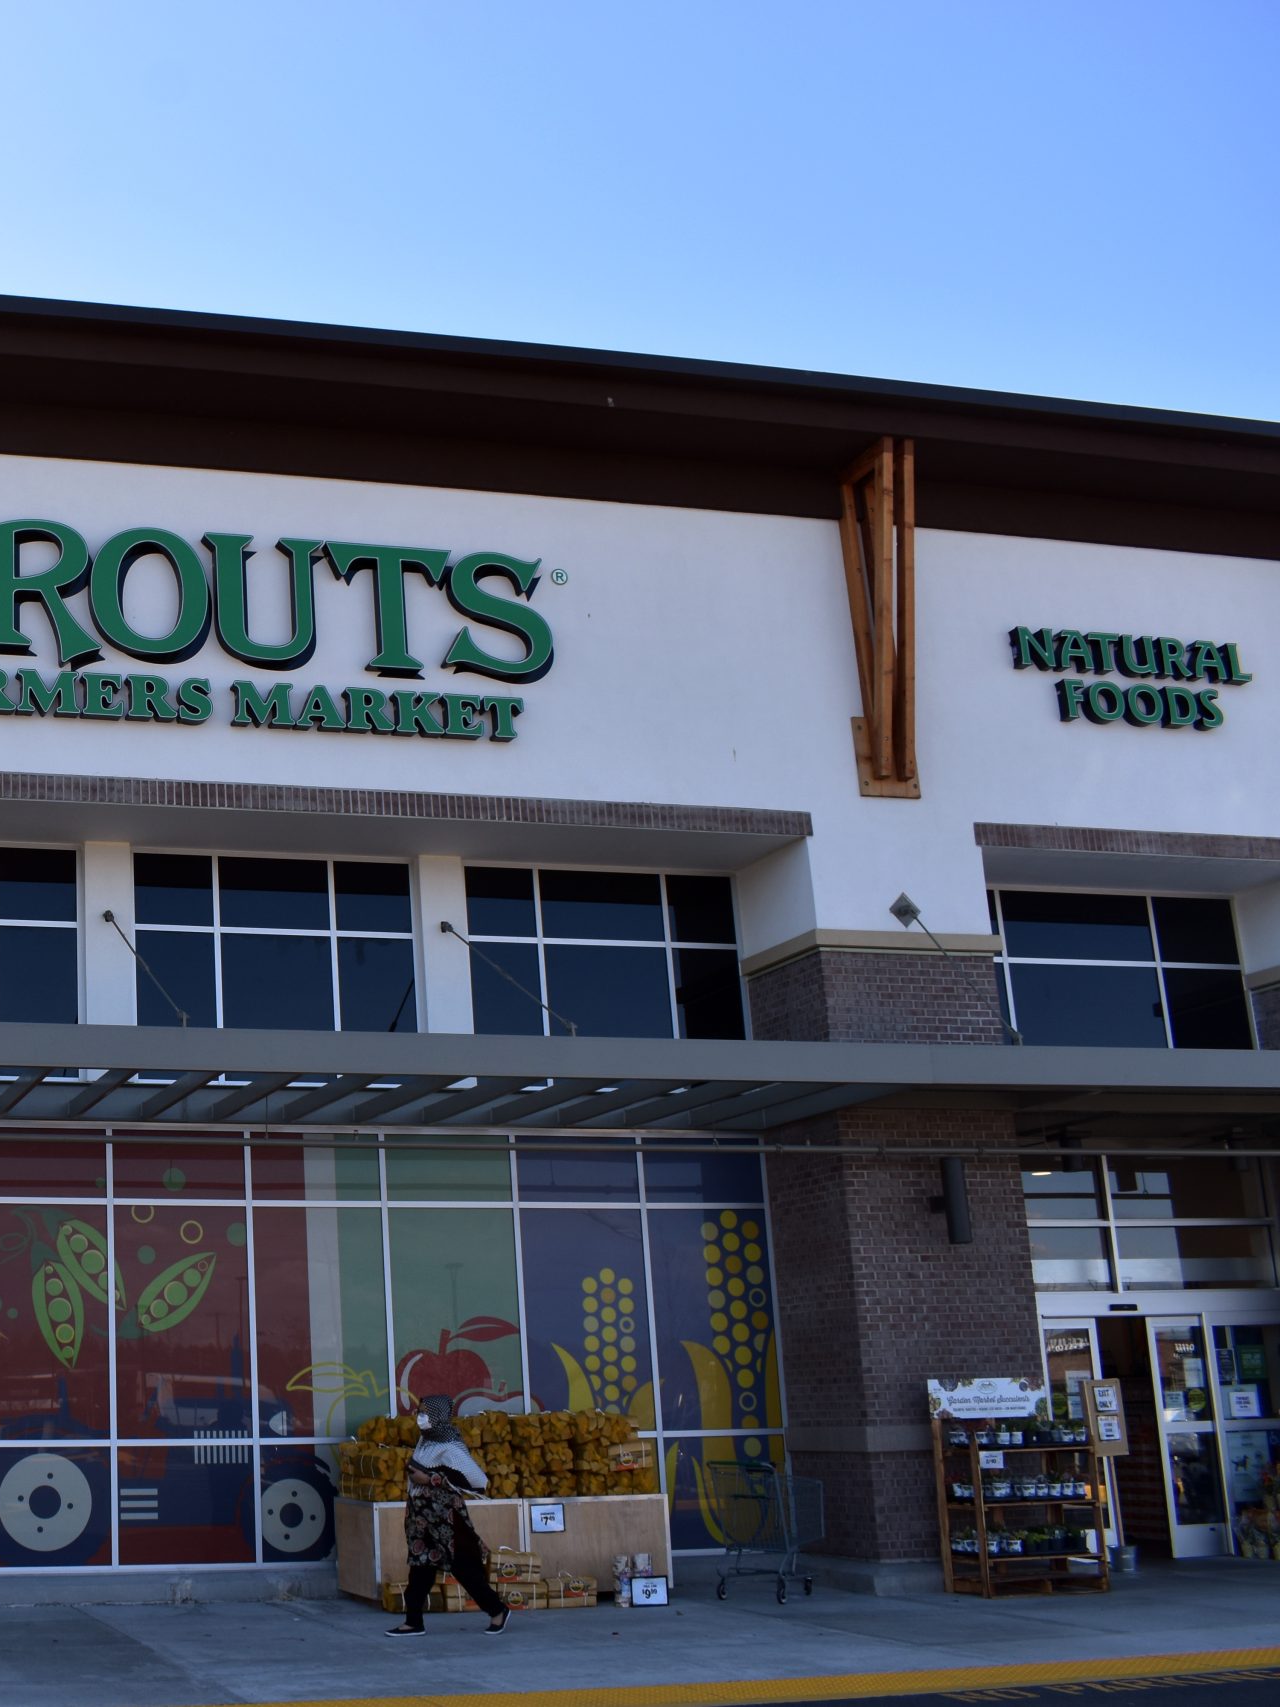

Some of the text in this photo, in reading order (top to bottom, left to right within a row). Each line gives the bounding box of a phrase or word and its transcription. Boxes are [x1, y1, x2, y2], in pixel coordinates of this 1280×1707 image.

[1008, 625, 1253, 686] NATURAL
[230, 679, 525, 744] MARKET
[1055, 678, 1224, 731] FOODS
[941, 1688, 1040, 1703] NO
